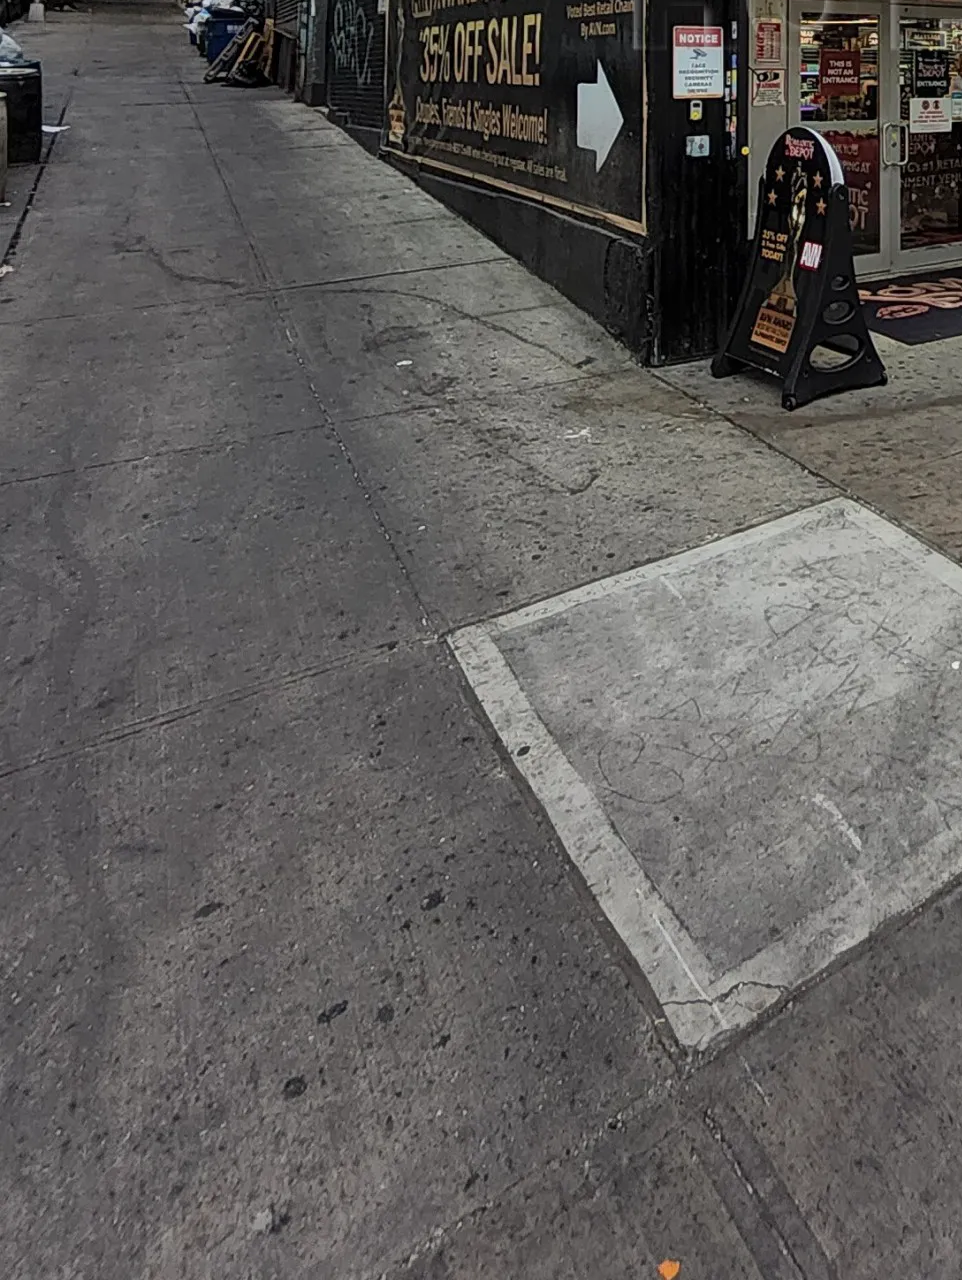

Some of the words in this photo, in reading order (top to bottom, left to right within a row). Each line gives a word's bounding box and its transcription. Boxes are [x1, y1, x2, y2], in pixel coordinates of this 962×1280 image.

[583, 1, 596, 18] Best
[678, 32, 719, 44] NOTICE
[453, 20, 485, 83] OFF
[485, 12, 542, 87] SALE!
[828, 60, 845, 68] THIS
[827, 68, 842, 76] NOT
[842, 68, 854, 76] AN
[822, 75, 859, 85] ENTRANCE
[473, 100, 501, 142] Singles
[501, 103, 548, 145] Welcome!
[789, 146, 815, 160] DEPOT
